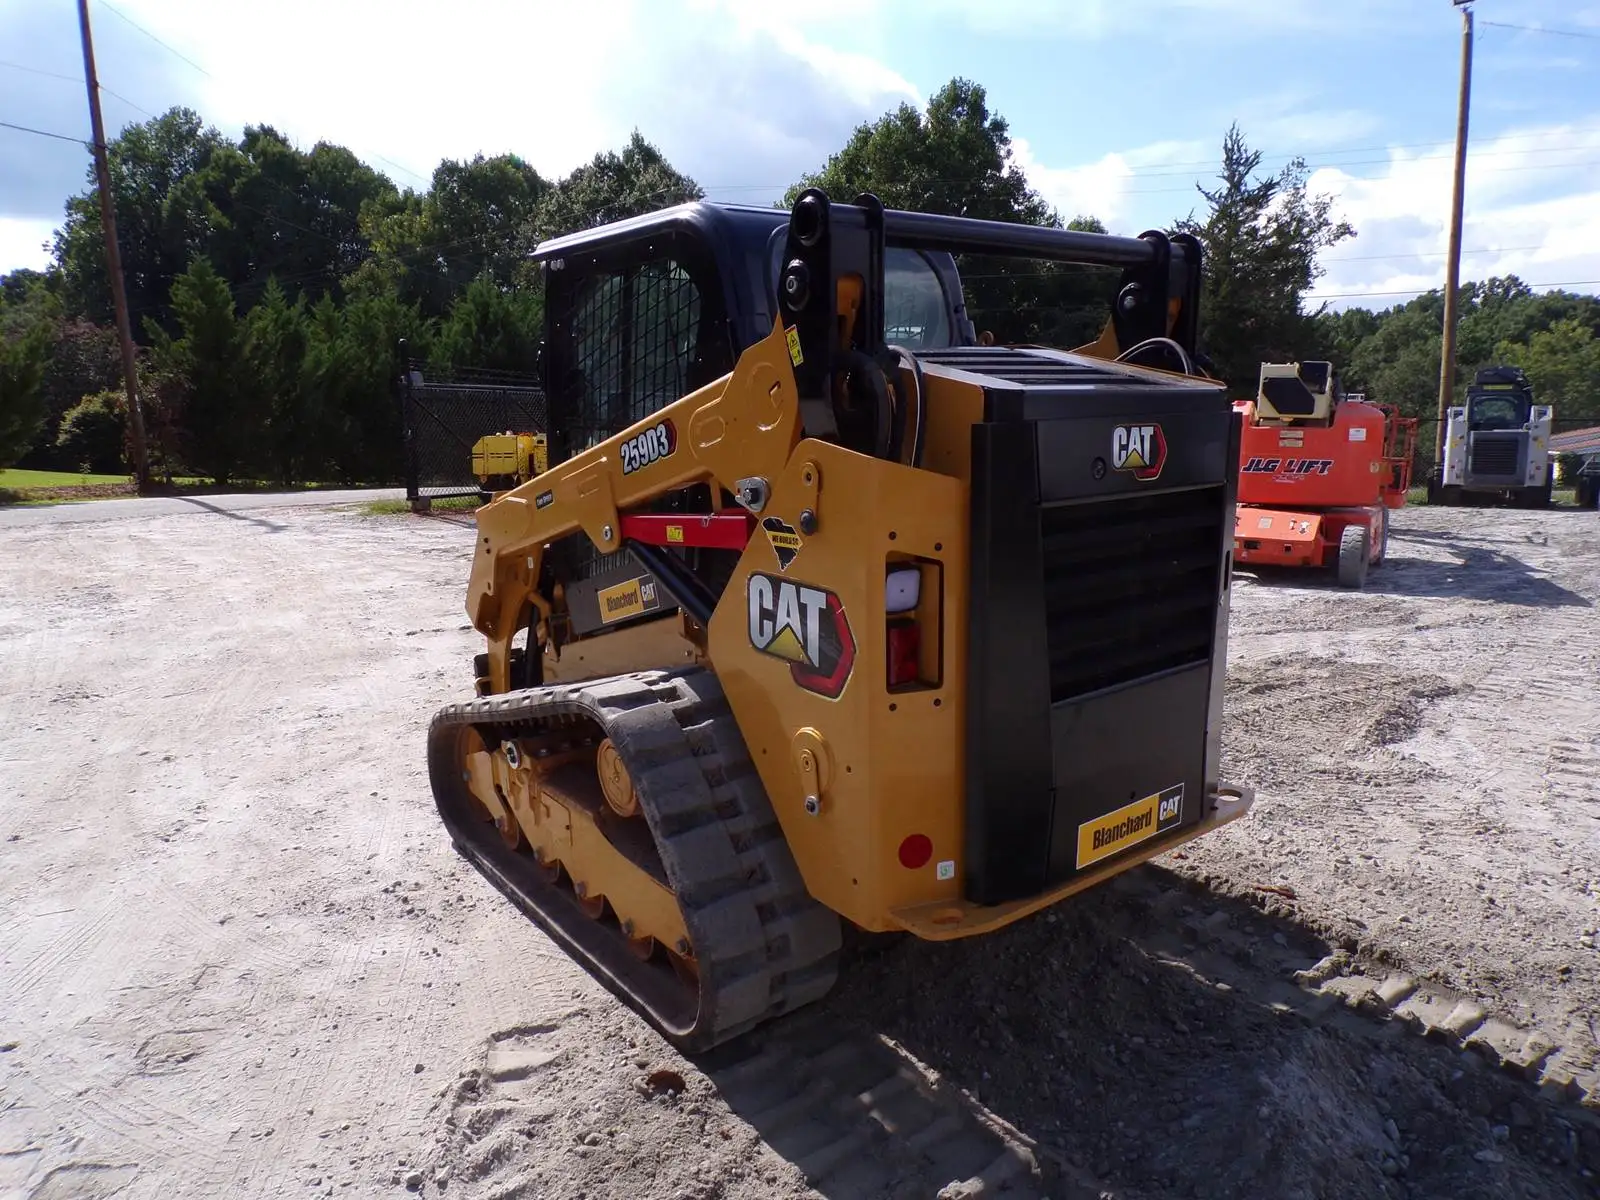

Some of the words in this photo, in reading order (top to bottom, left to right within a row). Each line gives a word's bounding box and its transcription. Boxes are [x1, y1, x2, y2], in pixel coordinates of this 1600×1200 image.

[620, 423, 669, 474] 259D3
[1113, 426, 1154, 468] CAT
[1240, 457, 1281, 473] JLG
[1281, 458, 1334, 475] LIFT
[606, 588, 639, 612] Blanchard
[641, 582, 655, 602] CAT
[749, 574, 827, 668] CAT
[1092, 807, 1153, 851] Blanchard
[1160, 795, 1181, 821] CAT
